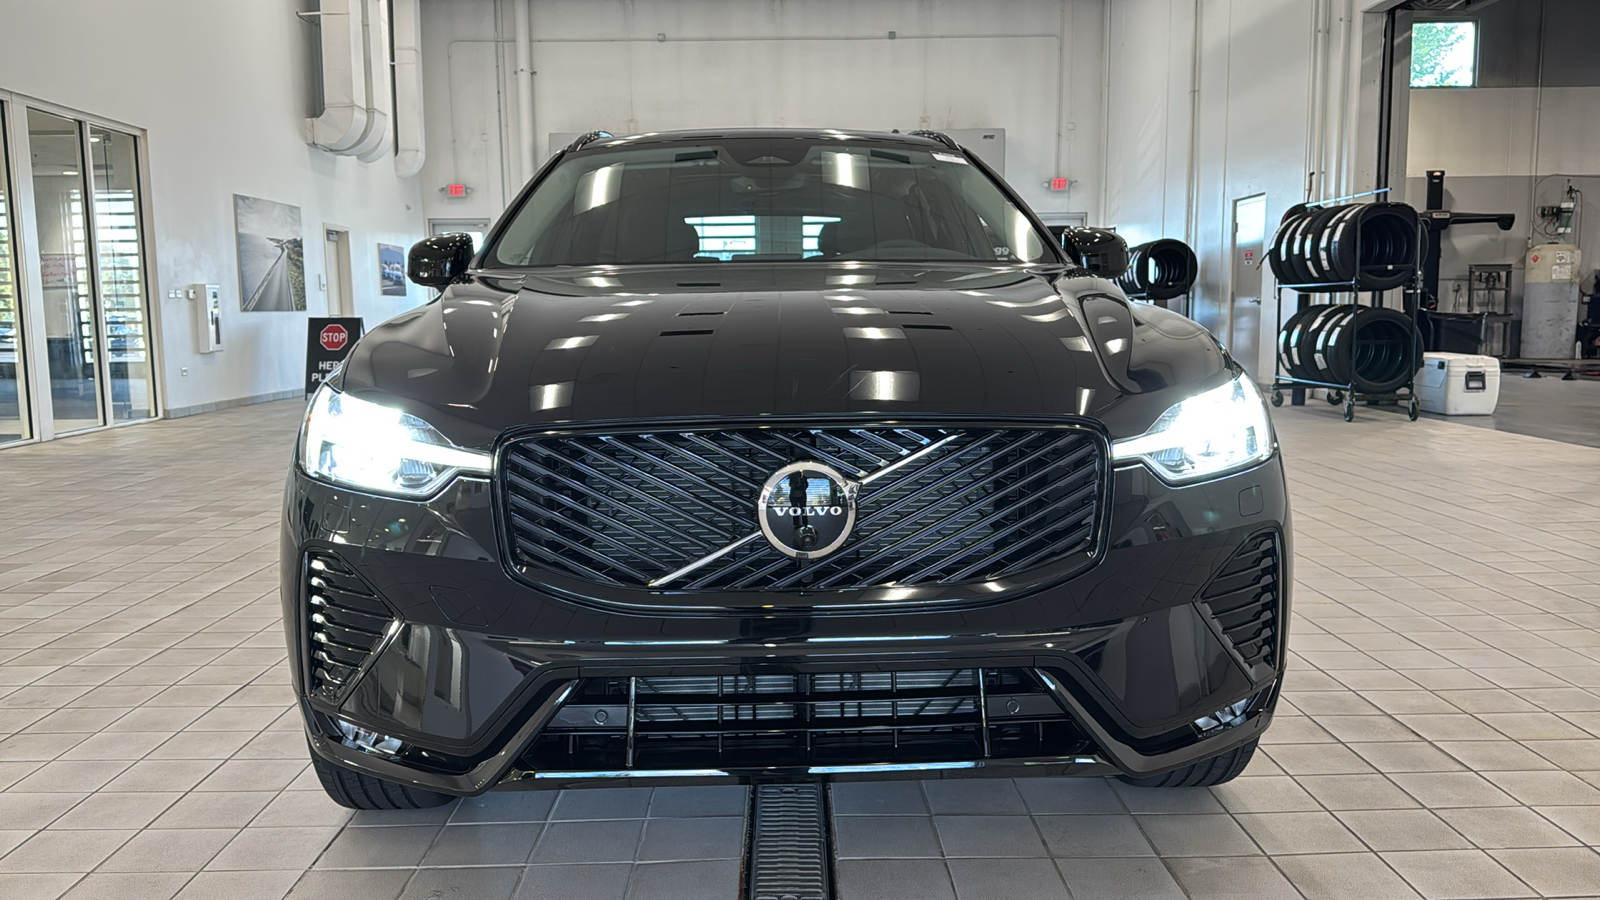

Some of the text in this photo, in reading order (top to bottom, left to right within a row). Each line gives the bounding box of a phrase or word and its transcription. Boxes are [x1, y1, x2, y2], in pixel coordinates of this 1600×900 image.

[322, 332, 346, 343] STOP
[318, 360, 341, 371] HER
[773, 506, 842, 517] VOLVO
